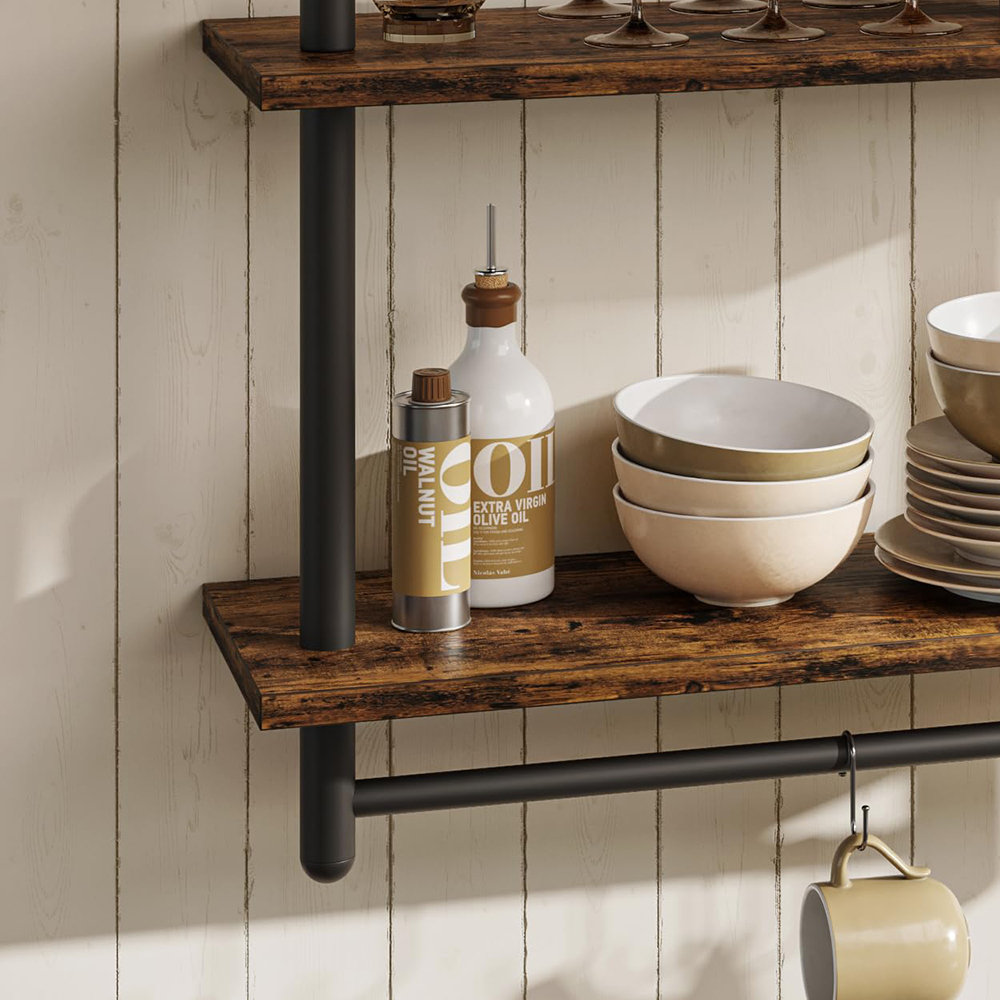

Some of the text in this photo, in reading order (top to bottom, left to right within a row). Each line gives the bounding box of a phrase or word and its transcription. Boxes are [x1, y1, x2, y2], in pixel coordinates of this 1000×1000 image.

[403, 446, 417, 477] OIL
[418, 446, 436, 528] WALNUT
[473, 493, 547, 513] EXTRA VIRGIN
[473, 510, 529, 526] OLIVE OIL
